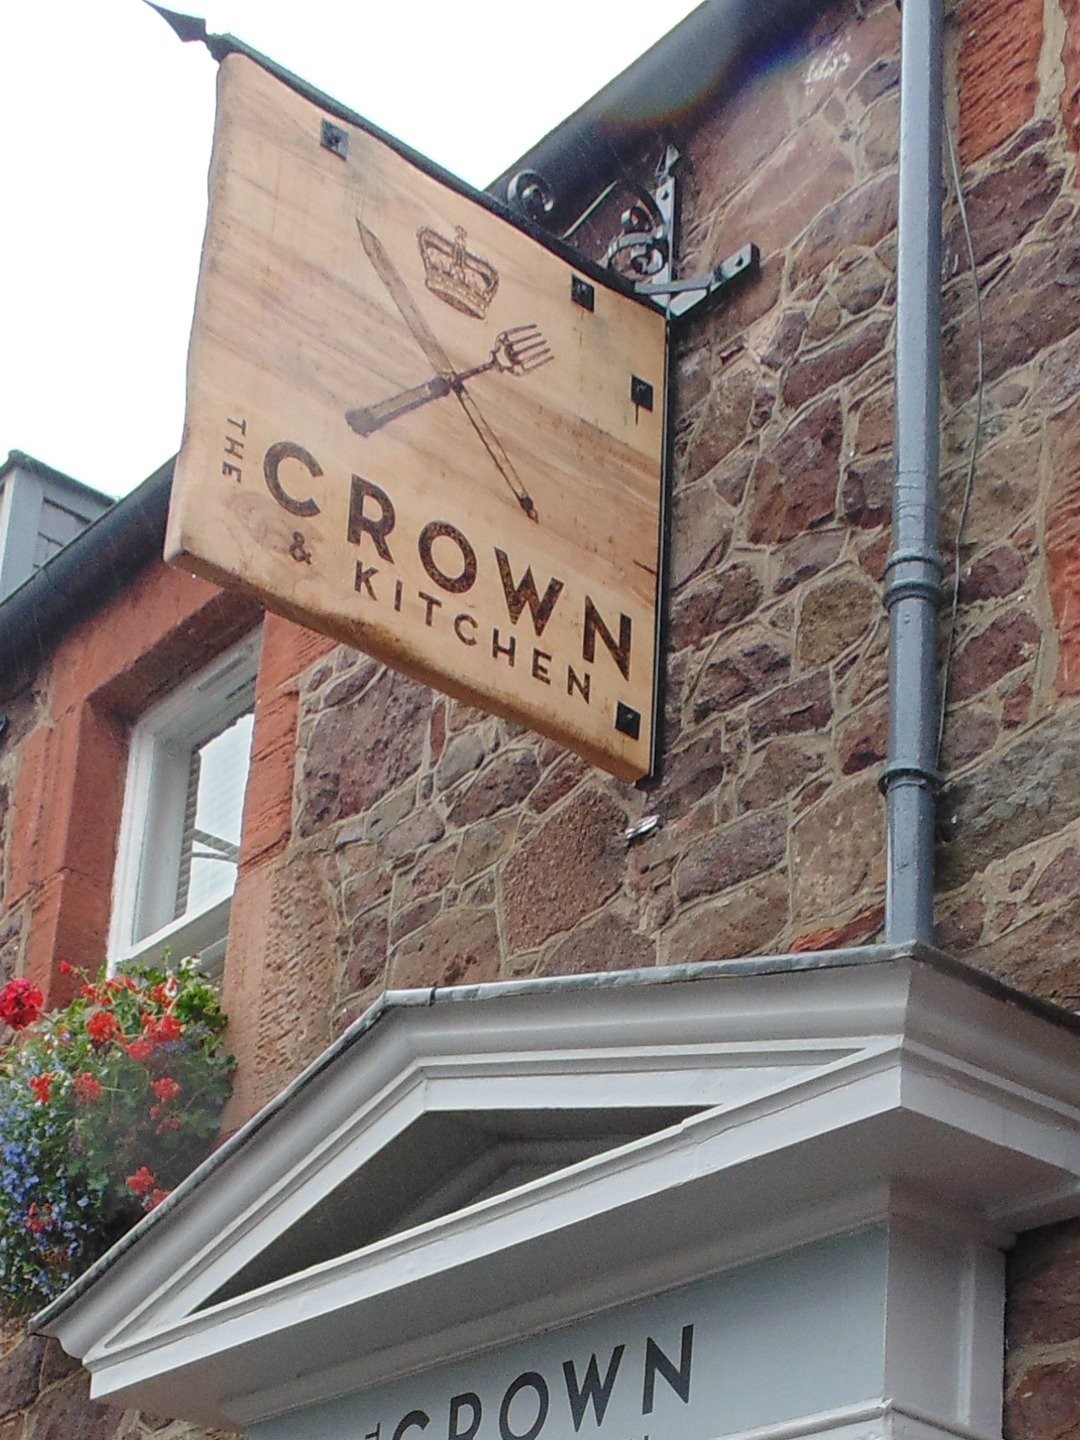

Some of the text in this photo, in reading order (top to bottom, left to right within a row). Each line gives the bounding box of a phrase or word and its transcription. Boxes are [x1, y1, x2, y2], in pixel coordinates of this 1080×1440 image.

[220, 417, 633, 682] THE CROWN
[288, 531, 592, 705] & KITCHEN
